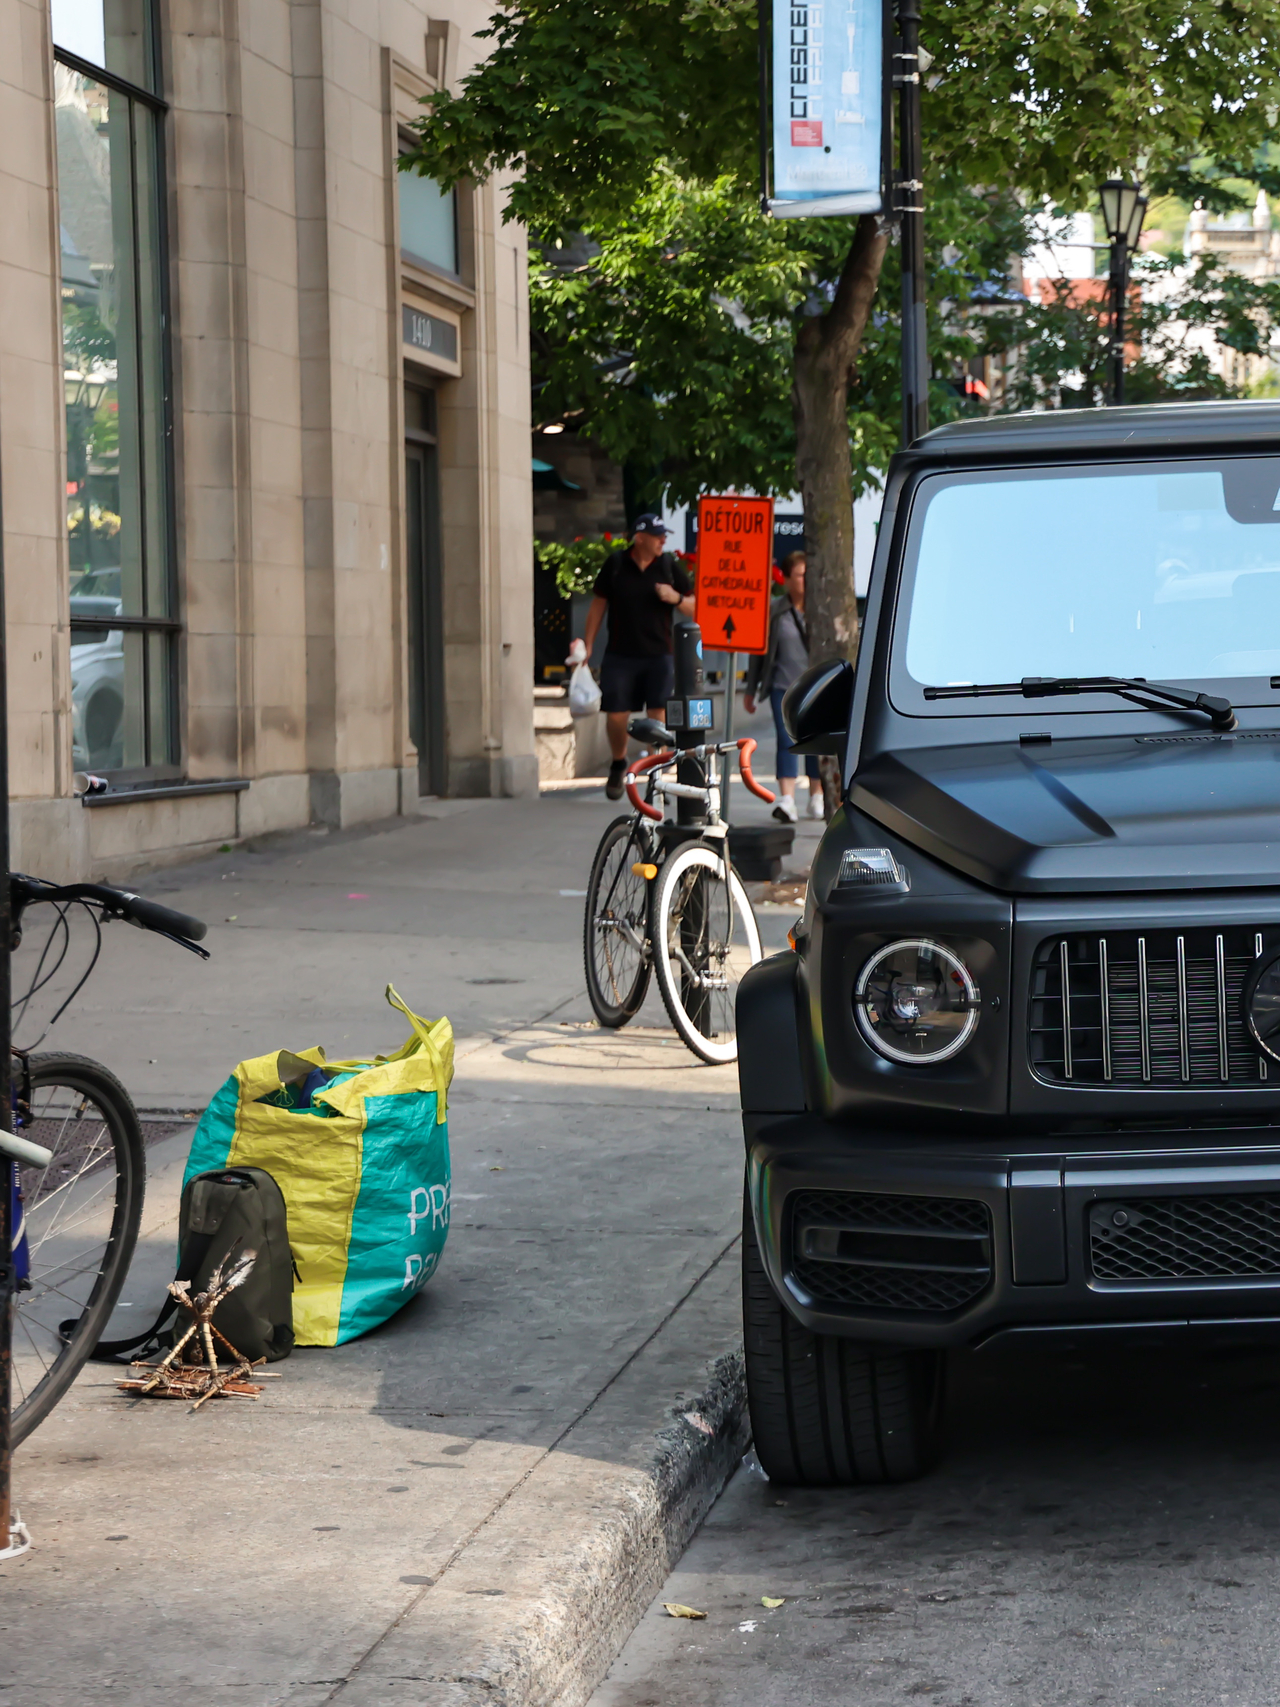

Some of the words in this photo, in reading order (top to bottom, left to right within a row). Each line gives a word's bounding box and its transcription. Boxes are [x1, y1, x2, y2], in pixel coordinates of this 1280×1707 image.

[412, 314, 432, 348] 1410
[704, 505, 764, 534] DÉTOUR
[723, 540, 743, 554] RUE
[718, 558, 731, 572] DE
[732, 559, 747, 572] LA
[701, 575, 763, 592] CATHÉDRALE
[707, 595, 756, 611] METCALFE
[697, 701, 704, 714] C
